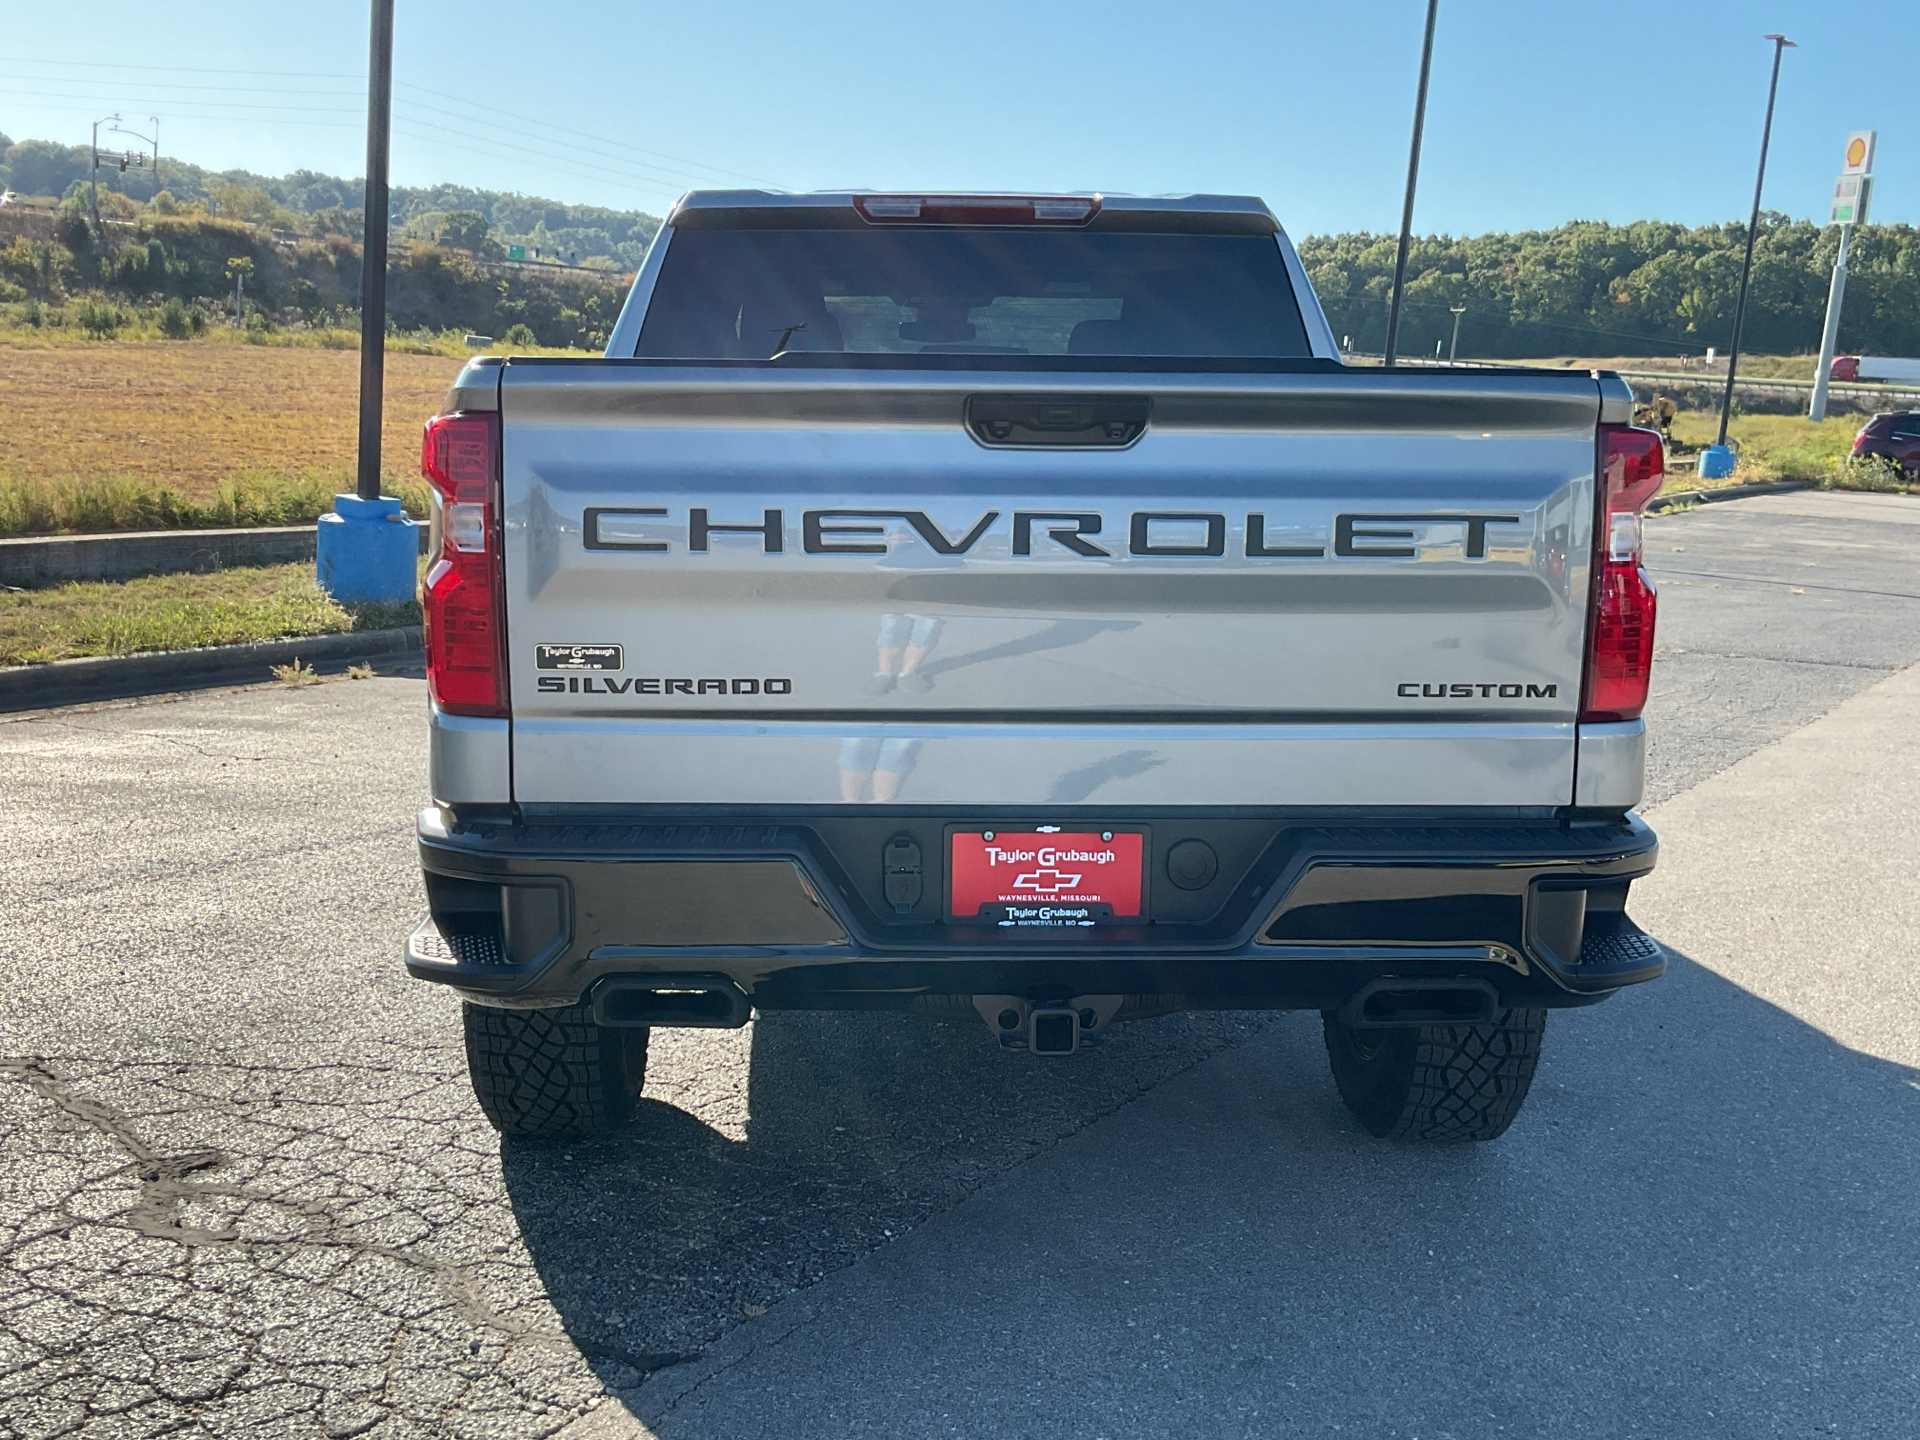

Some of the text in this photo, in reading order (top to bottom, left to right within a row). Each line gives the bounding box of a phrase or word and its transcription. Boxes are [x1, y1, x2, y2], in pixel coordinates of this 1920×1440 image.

[582, 506, 1520, 559] CHEVROLET
[542, 646, 615, 658] Taylor Grubaugh
[537, 676, 792, 695] SILVERADO
[1397, 683, 1557, 699] CUSTOM
[985, 847, 1115, 866] Taylor Grubaugh
[998, 894, 1058, 902] WAYNESVILLE,
[1005, 907, 1088, 919] Taylor Grubaugh
